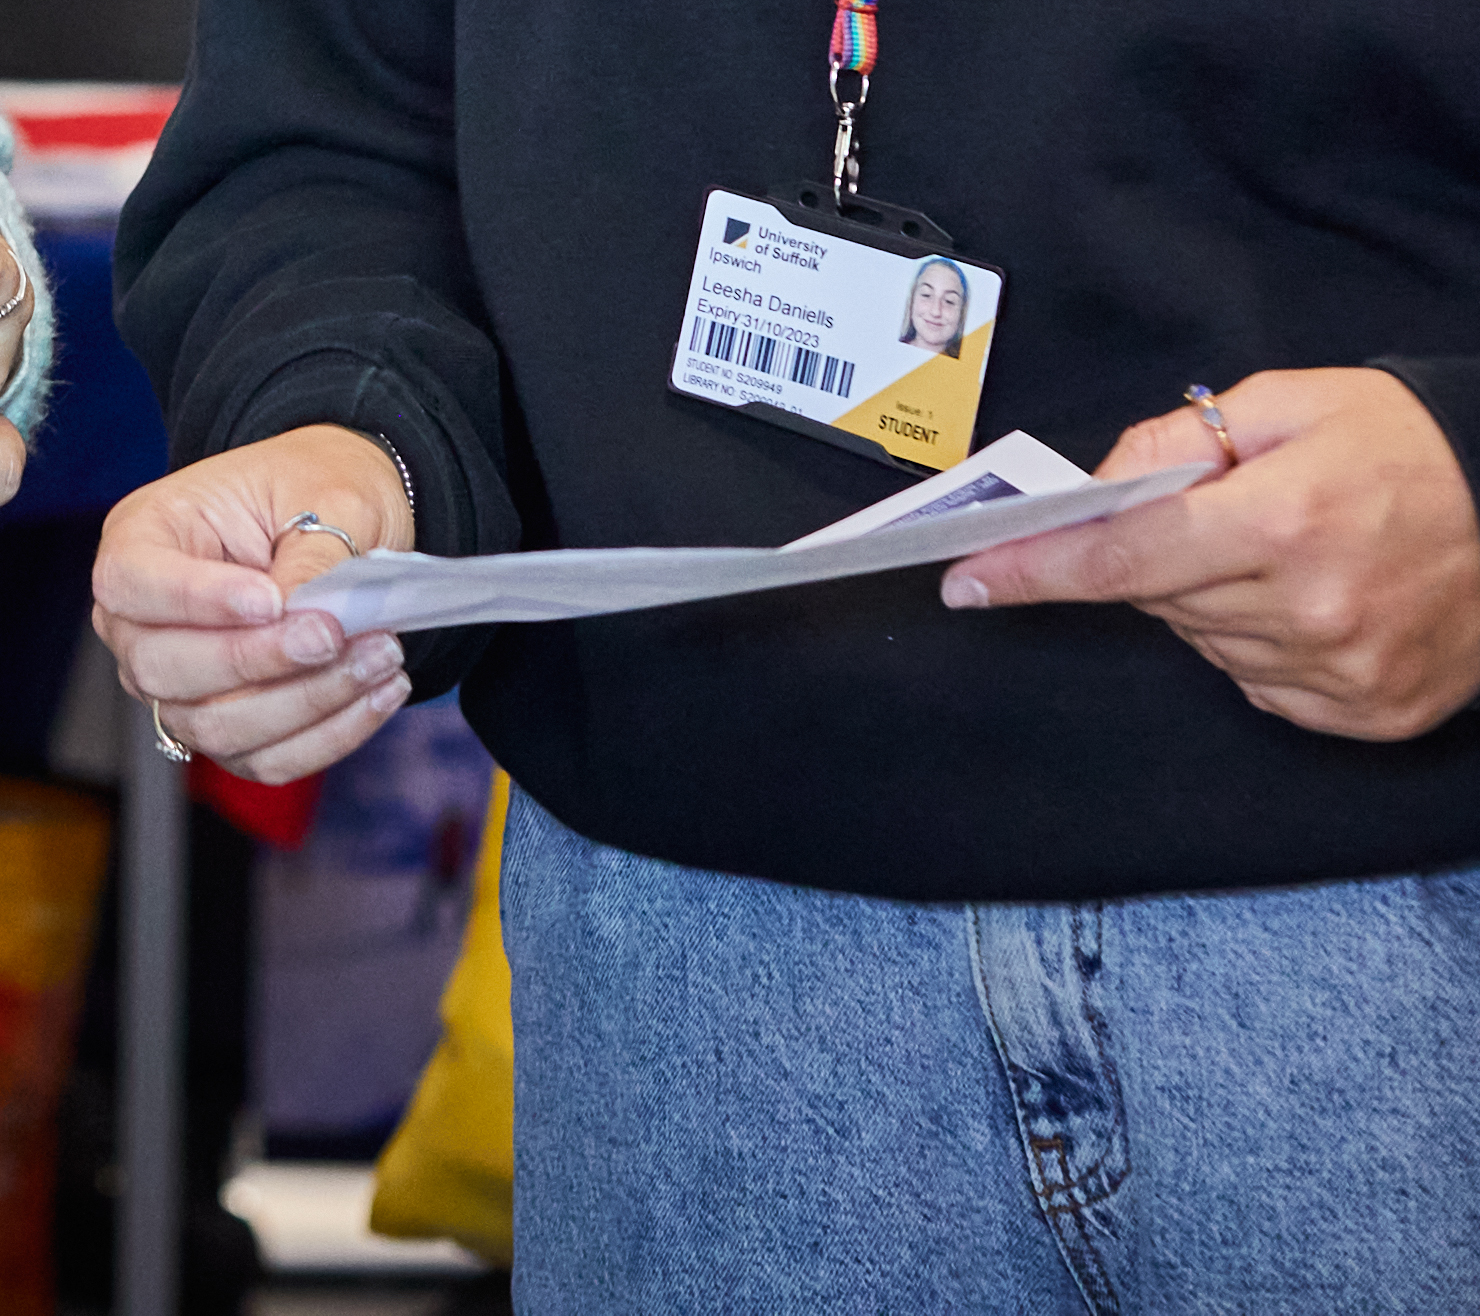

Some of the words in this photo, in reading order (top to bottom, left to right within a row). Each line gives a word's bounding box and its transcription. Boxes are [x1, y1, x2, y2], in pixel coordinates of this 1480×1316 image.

[755, 244, 770, 255] of
[772, 247, 819, 271] Suffolk
[758, 226, 828, 259] University
[709, 246, 762, 273] Ipswich
[702, 276, 763, 307] Leesha
[768, 294, 834, 329] Daniells
[683, 372, 719, 392] LIBRARY
[686, 357, 720, 375] STUDENT
[736, 372, 783, 395] S209949
[878, 414, 940, 446] STUDENT
